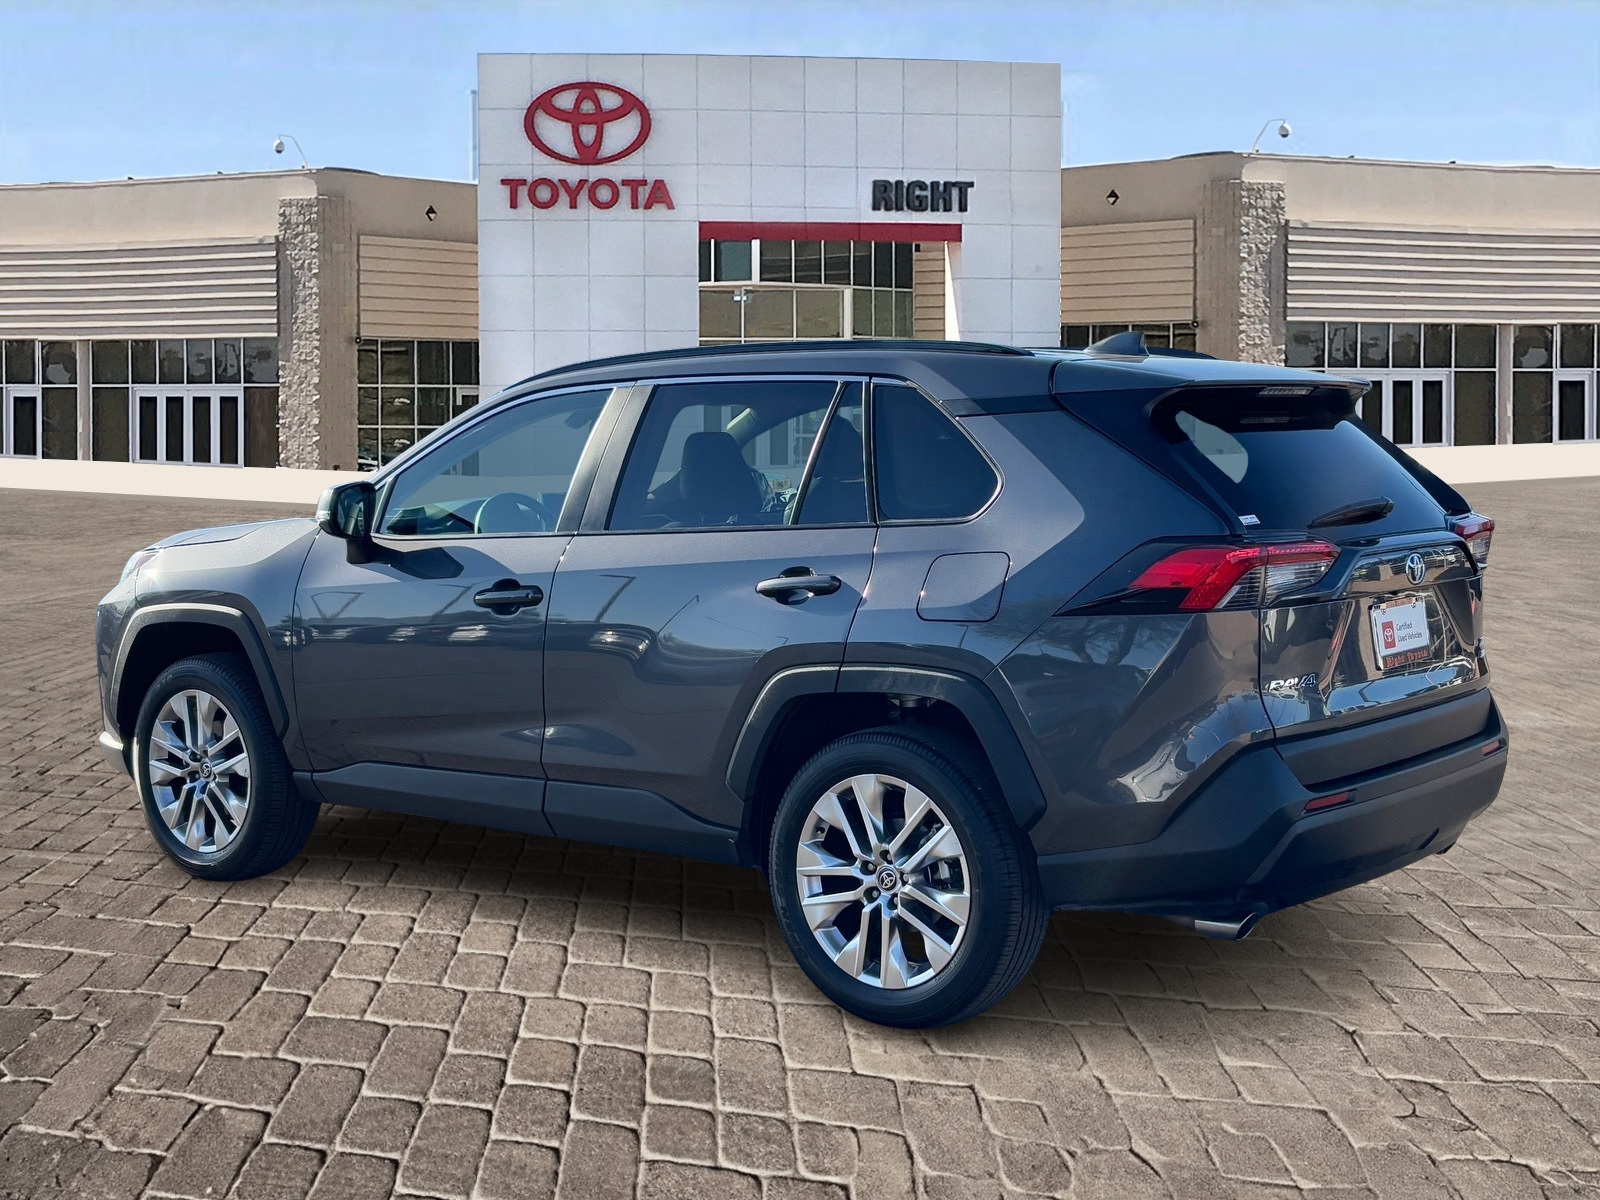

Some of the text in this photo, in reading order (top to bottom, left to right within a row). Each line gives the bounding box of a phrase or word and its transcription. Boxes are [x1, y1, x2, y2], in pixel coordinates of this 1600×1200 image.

[500, 178, 676, 210] TOYOTA
[871, 179, 975, 213] RIGHT
[1396, 621, 1413, 631] Certified
[1268, 673, 1316, 692] RAV4
